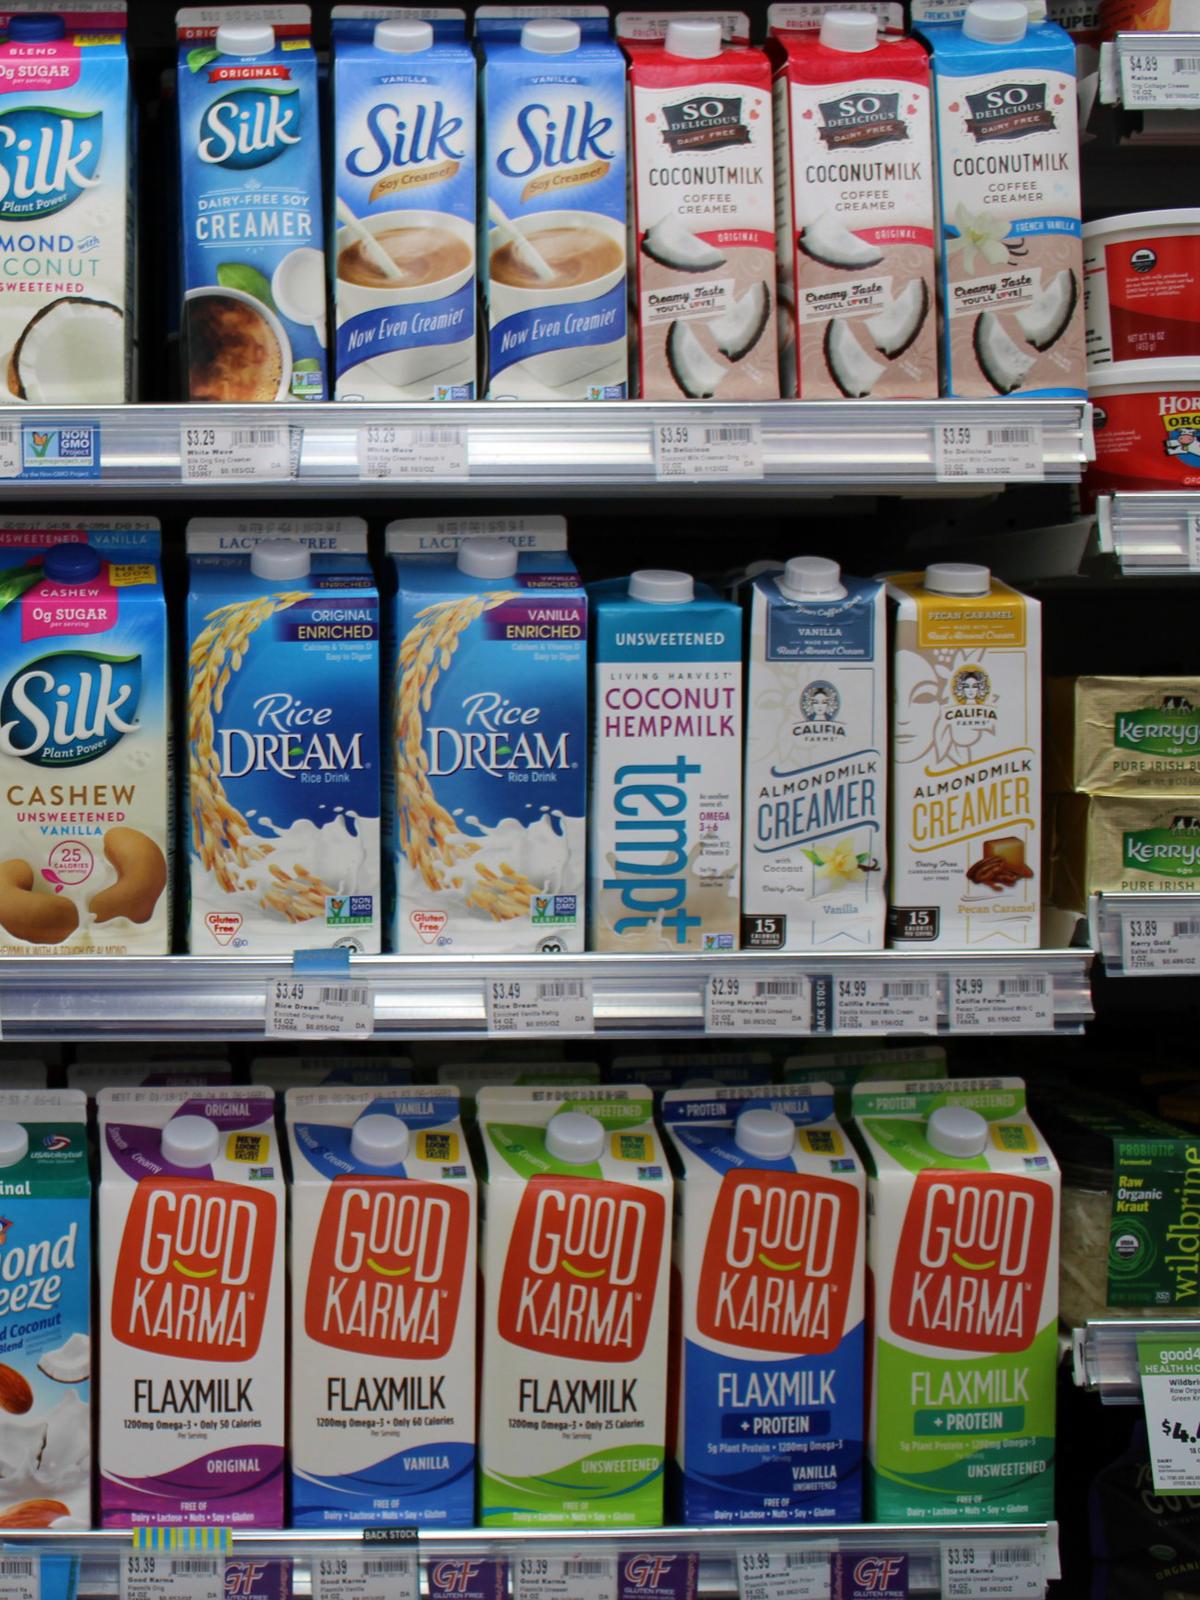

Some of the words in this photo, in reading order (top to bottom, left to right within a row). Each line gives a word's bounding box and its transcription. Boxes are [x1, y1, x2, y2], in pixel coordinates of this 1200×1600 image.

[18, 65, 70, 77] SUGAR
[220, 67, 279, 79] ORIGINAL
[380, 75, 428, 85] VANILLA
[987, 88, 1027, 106] SO
[976, 103, 1042, 120] DELICIOUS
[346, 101, 464, 177] Silk
[379, 177, 399, 193] Soy
[401, 166, 452, 187] Creamer
[649, 167, 763, 186] COCONUTMILK
[199, 196, 280, 210] DAIRY-FREE
[283, 196, 309, 207] SOY
[682, 193, 732, 203] COFFEE
[679, 204, 737, 214] CREAMER
[196, 211, 311, 239] CREAMER
[348, 325, 375, 352] Now
[379, 318, 407, 340] Even
[411, 308, 463, 334] Creamier
[62, 430, 89, 440] NON
[187, 430, 215, 446] $3.29
[661, 427, 688, 443] $3.59
[61, 439, 89, 449] GMO
[60, 447, 90, 457] Project
[312, 610, 372, 622] ORIGINAL
[528, 610, 579, 621] VANILLA
[928, 610, 962, 621] PECAN
[964, 609, 1014, 620] CARAMEL
[298, 626, 373, 639] ENRICHED
[615, 633, 724, 645] UNSWEETENED
[798, 627, 843, 637] VANILLA
[609, 673, 659, 681] LIVING
[668, 672, 730, 681] HARVEST
[605, 688, 735, 709] COCONUT
[253, 694, 332, 727] Rice
[605, 716, 734, 736] HEMPMILK
[793, 726, 845, 737] CALIFIA
[219, 730, 362, 778] DREAM
[1114, 761, 1144, 771] PURE
[1151, 761, 1184, 771] IRISH
[301, 773, 321, 783] Rice
[324, 773, 350, 783] Drink
[759, 761, 876, 798] ALMONDMILK
[758, 780, 875, 841] CREAMER
[604, 755, 701, 943] tempt
[209, 915, 239, 926] Gluten
[755, 920, 775, 932] 15
[213, 923, 235, 934] Free
[1130, 921, 1157, 935] $3.89
[1130, 940, 1151, 948] Kerry
[276, 983, 304, 999] $3.49
[712, 979, 739, 995] $2.99
[816, 979, 826, 1006] STOCK
[955, 979, 982, 994] $4.99
[274, 1002, 293, 1010] Rice
[295, 1003, 320, 1012] Dream
[816, 1008, 826, 1032] BACK
[236, 1135, 261, 1145] NEW
[1120, 1144, 1174, 1156] PROBIOTIC
[1119, 1175, 1143, 1187] Raw
[1118, 1187, 1162, 1201] Organic
[1116, 1201, 1149, 1212] Kraut
[140, 1190, 257, 1286] GOOD
[129, 1279, 246, 1348] KARMA
[9, 1314, 61, 1338] Coconut
[1144, 1363, 1184, 1374] HEALTH
[719, 1370, 836, 1407] FLAXMILK
[134, 1379, 253, 1413] FLAXMILK
[124, 1420, 154, 1430] 1200mg
[156, 1419, 192, 1430] Omega-3
[200, 1419, 218, 1429] Only
[219, 1419, 230, 1429] 50
[230, 1418, 263, 1429] Calories
[754, 1417, 809, 1434] PROTEIN
[207, 1460, 260, 1473] ORIGINAL
[582, 1458, 659, 1472] UNSWEETENED
[364, 1529, 389, 1539] BACK
[390, 1528, 417, 1538] STOCK
[948, 1548, 975, 1563] $3.99
[128, 1557, 155, 1573] $3.39
[624, 1555, 677, 1588] GF
[624, 1587, 654, 1596] GLUTEN
[656, 1588, 676, 1596] FREE
